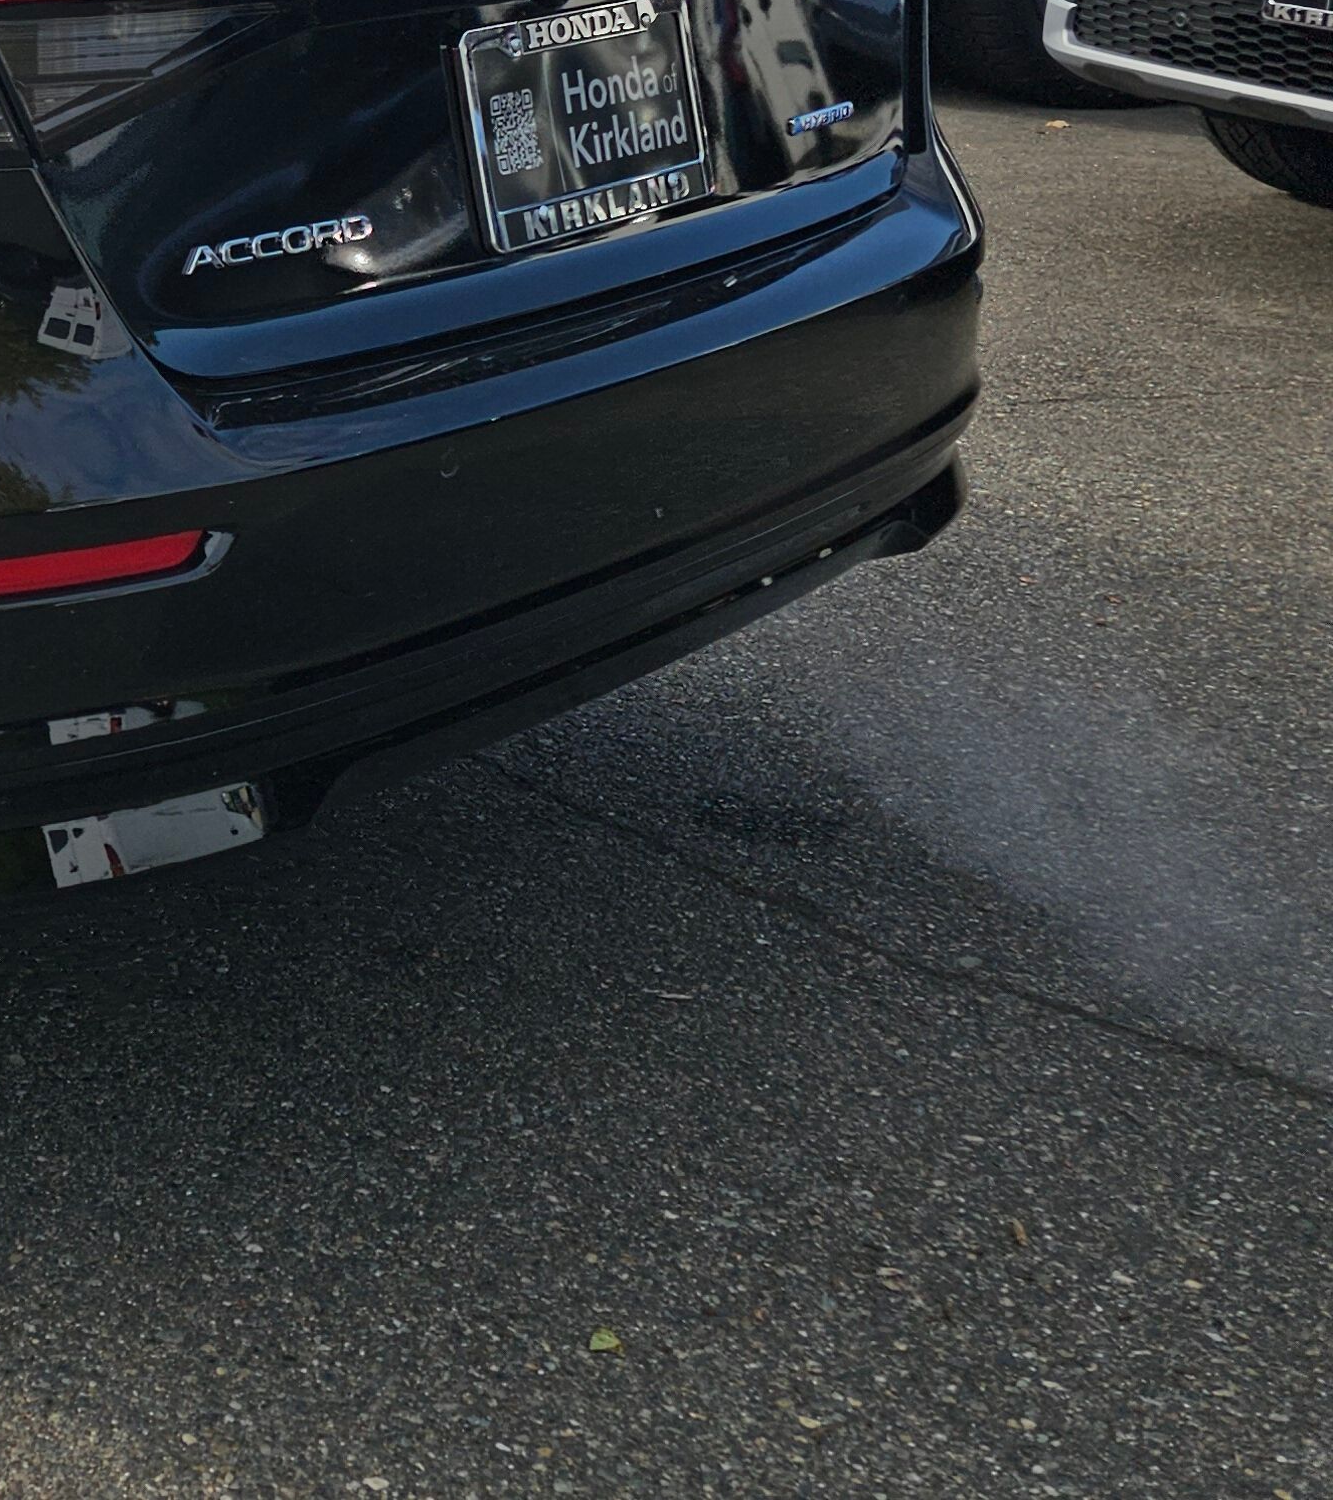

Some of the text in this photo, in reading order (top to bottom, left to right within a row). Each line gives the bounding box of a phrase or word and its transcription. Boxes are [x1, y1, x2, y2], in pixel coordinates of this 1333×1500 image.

[525, 6, 635, 49] HONDA
[1273, 5, 1333, 28] KIR
[561, 55, 679, 114] Honda of
[568, 99, 688, 168] Kirkland
[523, 171, 690, 241] KIRKLAND
[182, 214, 373, 276] ACCORD
